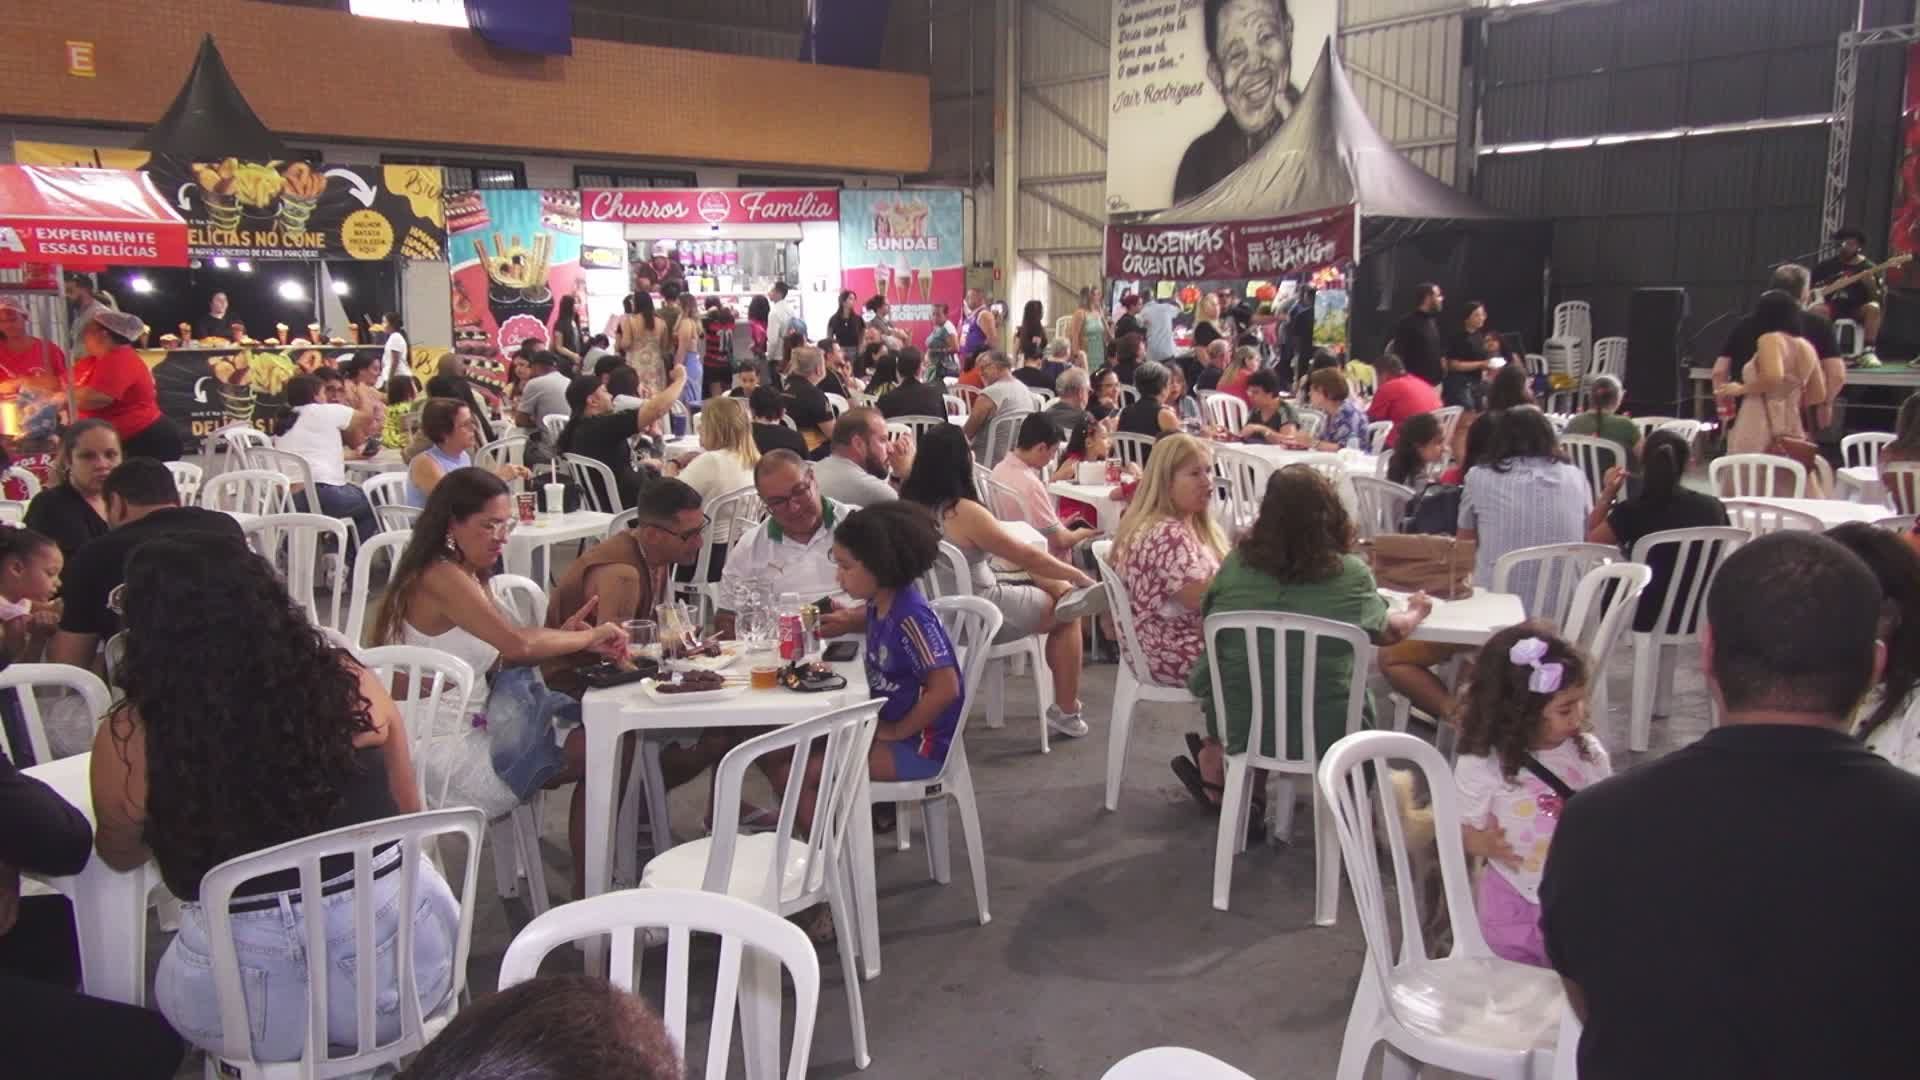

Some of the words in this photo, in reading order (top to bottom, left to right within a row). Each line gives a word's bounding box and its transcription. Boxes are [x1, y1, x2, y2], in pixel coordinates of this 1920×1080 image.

[1112, 88, 1140, 112] Jair
[1143, 81, 1204, 105] Rodrigues
[591, 191, 689, 220] Churros
[739, 191, 833, 220] Família
[36, 227, 156, 245] EXPERIMENTE
[187, 225, 251, 246] ELÍCIAS
[255, 230, 279, 247] NO
[282, 231, 326, 248] CONE
[867, 237, 939, 251] SUNDAE
[39, 242, 89, 255] ESSAS
[92, 242, 158, 258] DELÍCIAS
[1122, 253, 1206, 278] ORIENTAIS
